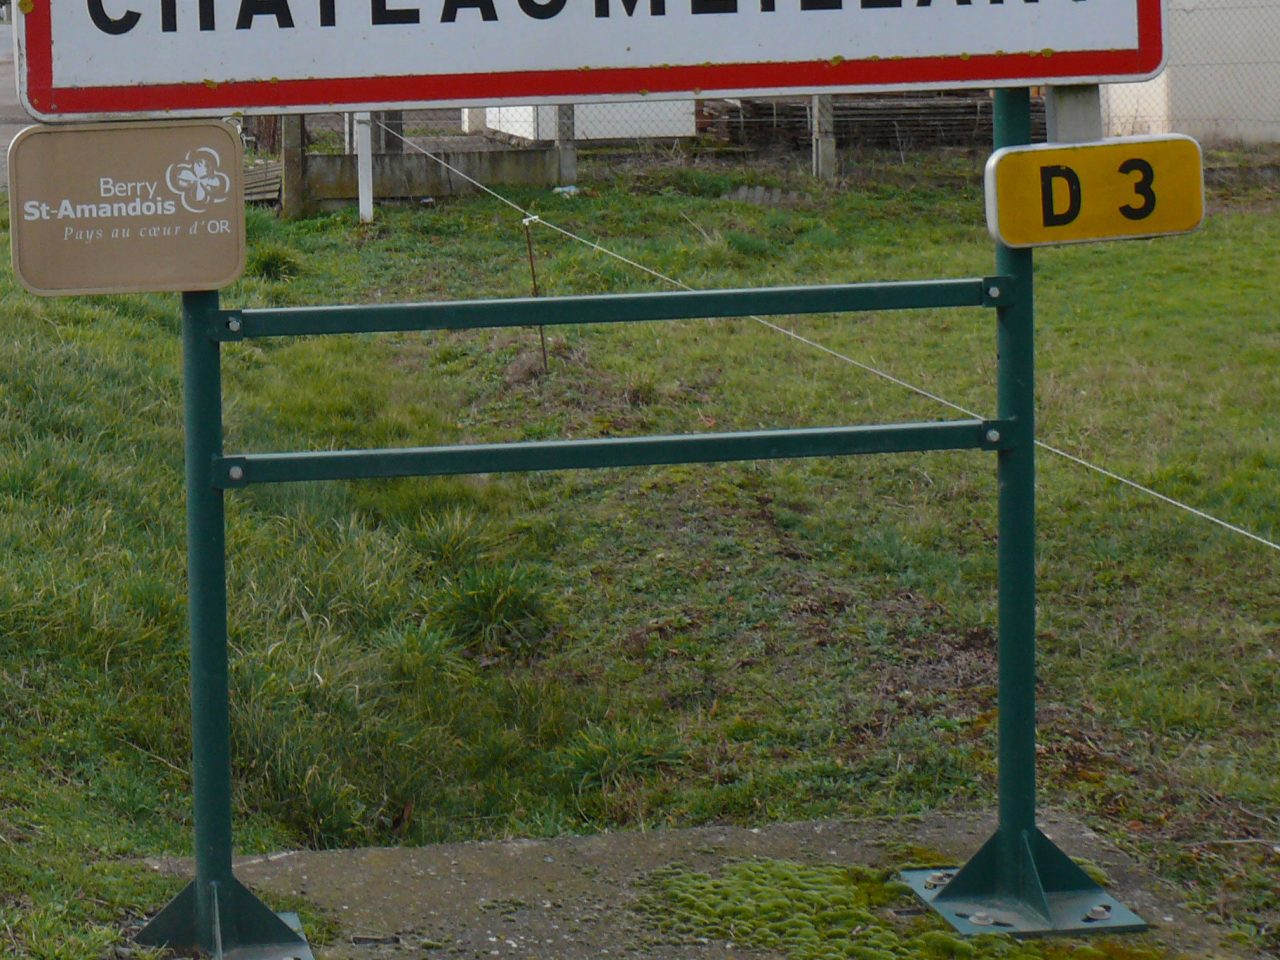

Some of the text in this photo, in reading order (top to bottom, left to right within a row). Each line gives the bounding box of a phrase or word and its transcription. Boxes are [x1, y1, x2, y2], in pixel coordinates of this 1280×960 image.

[99, 177, 158, 200] Berry
[1040, 158, 1156, 228] D 3
[23, 196, 177, 221] St-Amandois
[63, 226, 104, 244] Pays
[111, 227, 131, 239] au
[189, 219, 232, 235] d'OR
